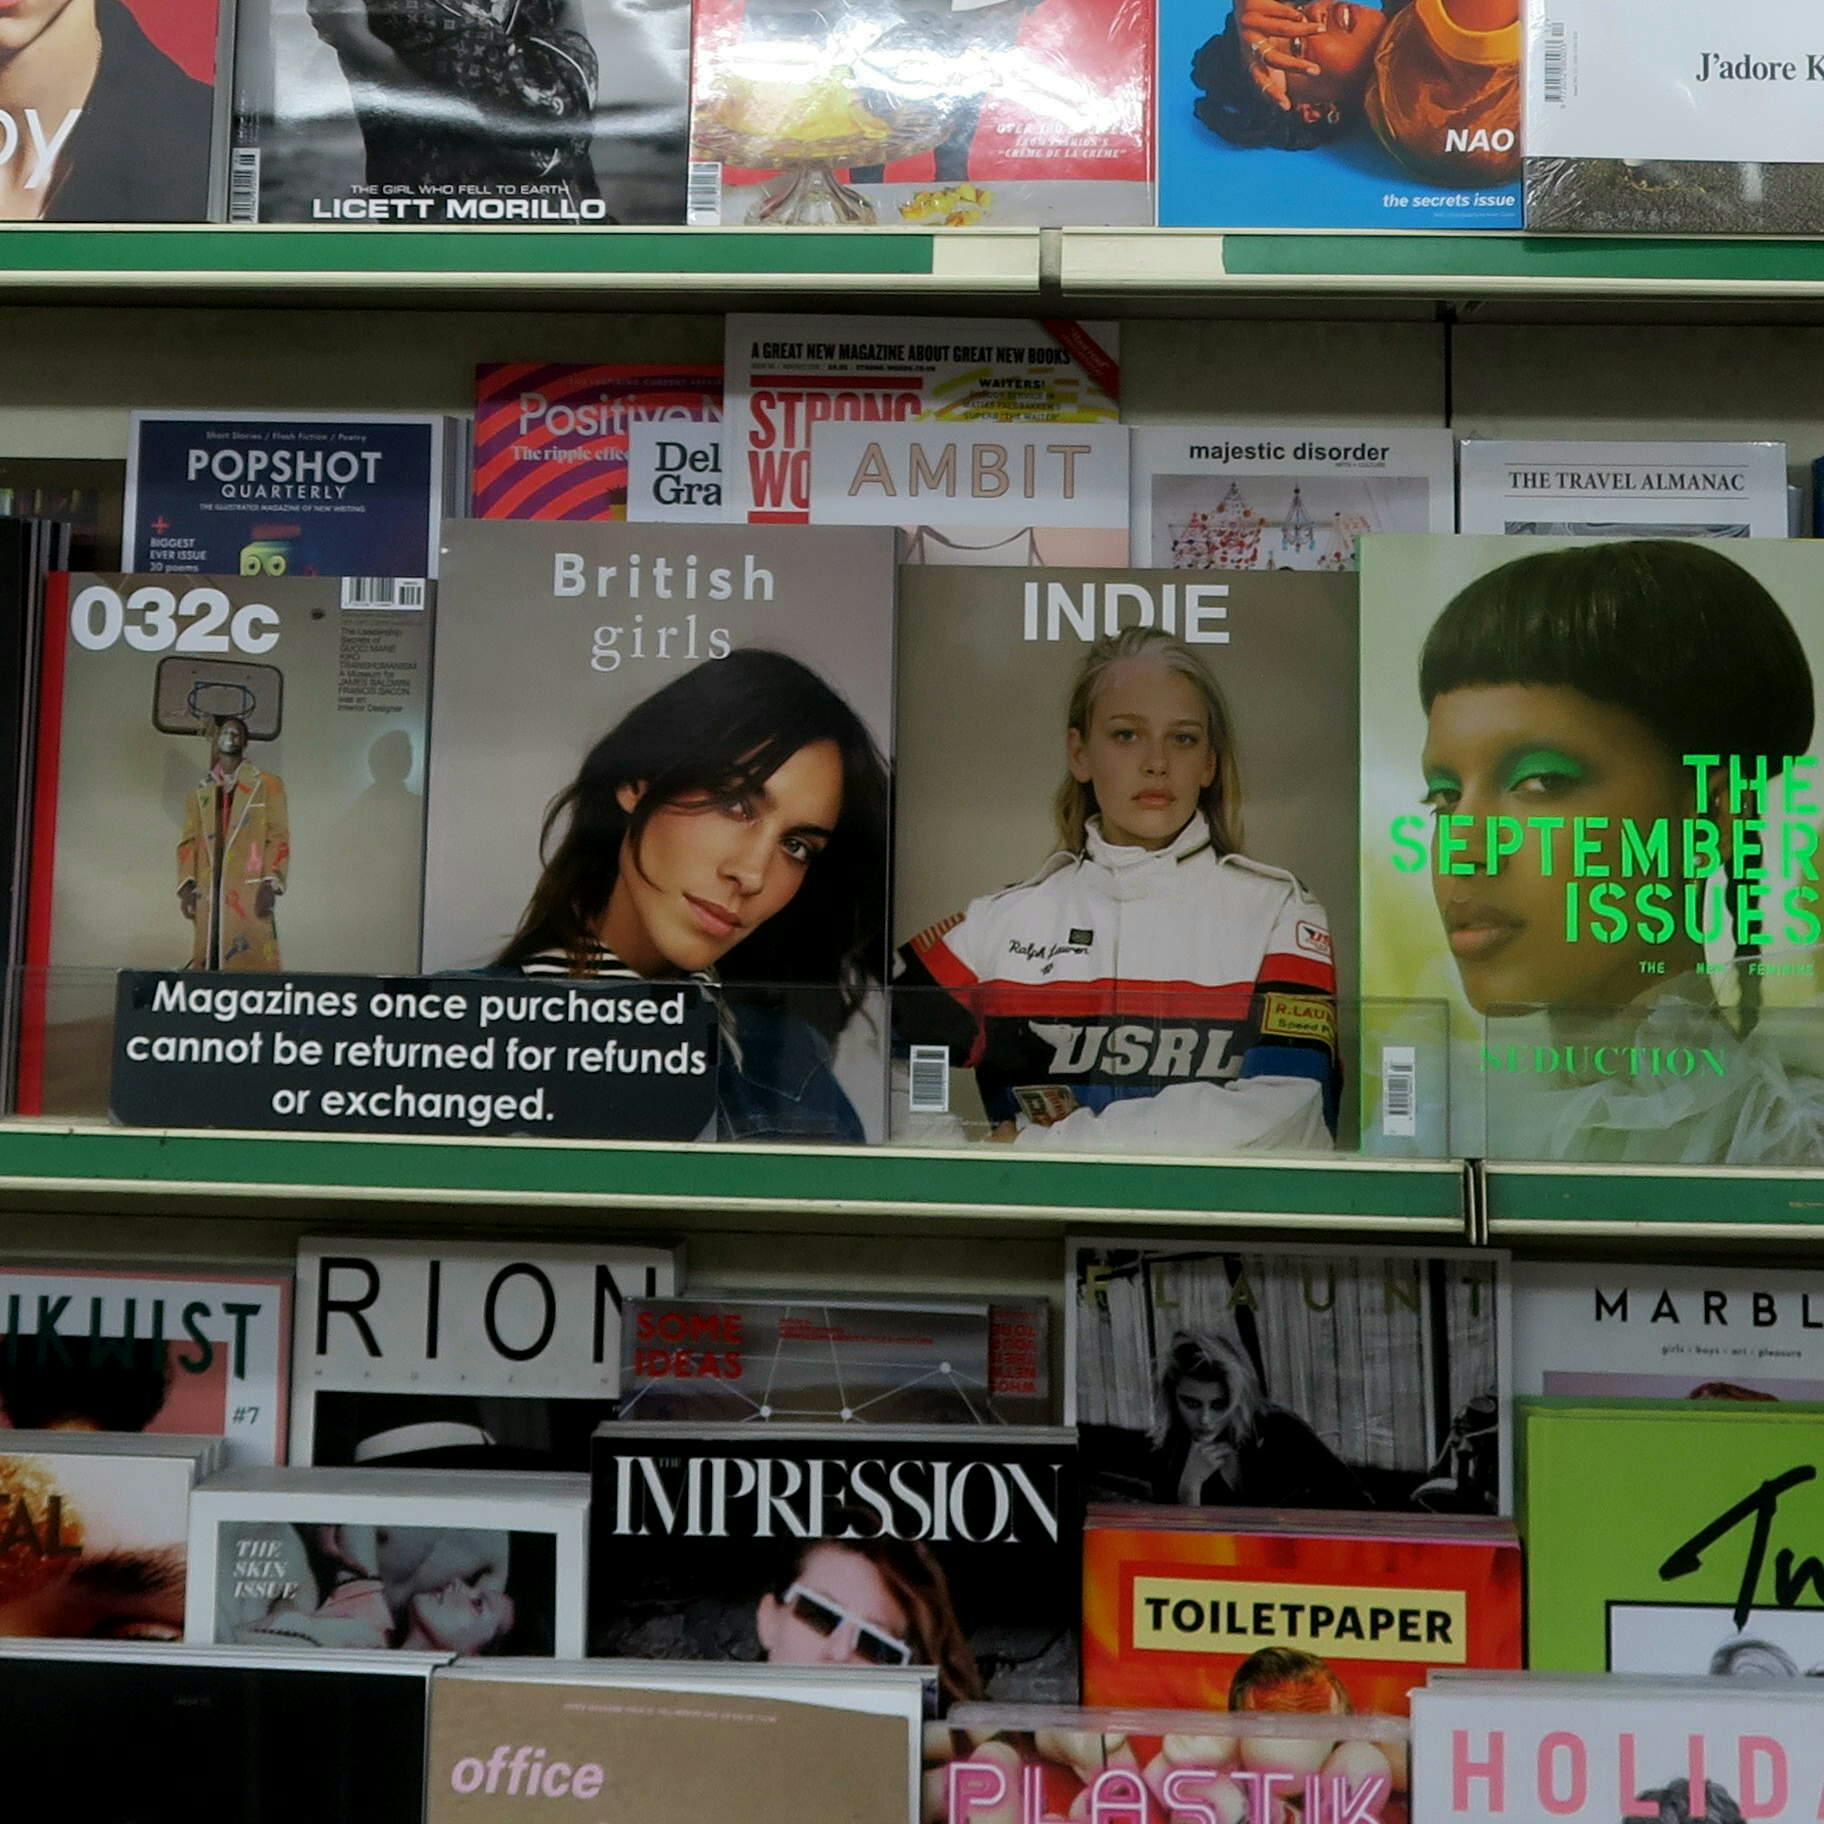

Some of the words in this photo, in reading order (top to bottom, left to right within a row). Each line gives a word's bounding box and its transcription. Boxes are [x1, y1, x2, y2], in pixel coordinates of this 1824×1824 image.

[1444, 126, 1516, 154] NAO
[350, 184, 378, 195] THE
[383, 184, 415, 195] GIRL
[418, 184, 454, 195] WHO
[459, 185, 491, 195] FELL
[497, 185, 516, 195] TO
[520, 185, 569, 195] EARTH
[1382, 193, 1406, 208] the
[1409, 194, 1470, 210] secrets
[1473, 193, 1516, 208] issue
[312, 198, 434, 219] LICETT
[446, 198, 606, 219] MORILLO
[751, 342, 759, 359] A
[763, 343, 803, 360] GREAT
[807, 343, 835, 361] NEW
[838, 344, 905, 362] MAGAZINE
[908, 344, 950, 363] ABOUT
[953, 345, 993, 364] GREAT
[996, 346, 1024, 364] NEW
[1028, 347, 1071, 365] BOOKS
[187, 448, 382, 484] POPSHOT
[1188, 439, 1285, 463] majestic
[1292, 440, 1390, 462] disorder
[847, 442, 1091, 499] AMBIT
[1508, 469, 1550, 492] THE
[1554, 469, 1635, 492] TRAVEL
[1638, 470, 1745, 493] ALMANAC
[221, 484, 347, 501] QUARTERLY
[149, 537, 195, 548] BIGGEST
[553, 552, 776, 602] British
[70, 586, 281, 655] 032c
[1023, 580, 1231, 645] INDIE
[591, 614, 733, 672] girls
[1682, 753, 1819, 817] THE
[1390, 814, 1822, 881] SEPTEMBER
[1566, 883, 1823, 947] ISSUES
[150, 980, 358, 1023] Magazines
[369, 990, 469, 1024] once
[479, 989, 686, 1027] purchased
[125, 1028, 263, 1065] cannot
[272, 1029, 323, 1068] be
[334, 1031, 495, 1072] returned
[504, 1031, 559, 1072] for
[566, 1036, 709, 1076] refunds
[1477, 1043, 1728, 1079] SEDUCTION
[271, 1087, 311, 1117] or
[320, 1081, 555, 1126] exchanged.
[1087, 1265, 1491, 1314] FLAUNT
[635, 1310, 745, 1346] SOME
[632, 1346, 745, 1380] IDEAS
[231, 1403, 261, 1427] #7
[611, 1454, 1063, 1545] IMPRESSION
[235, 1539, 283, 1560] THE
[233, 1561, 288, 1579] SKIN
[233, 1580, 298, 1600] ISSUE
[1144, 1596, 1454, 1645] TOILETPAPER
[450, 1745, 606, 1801] office
